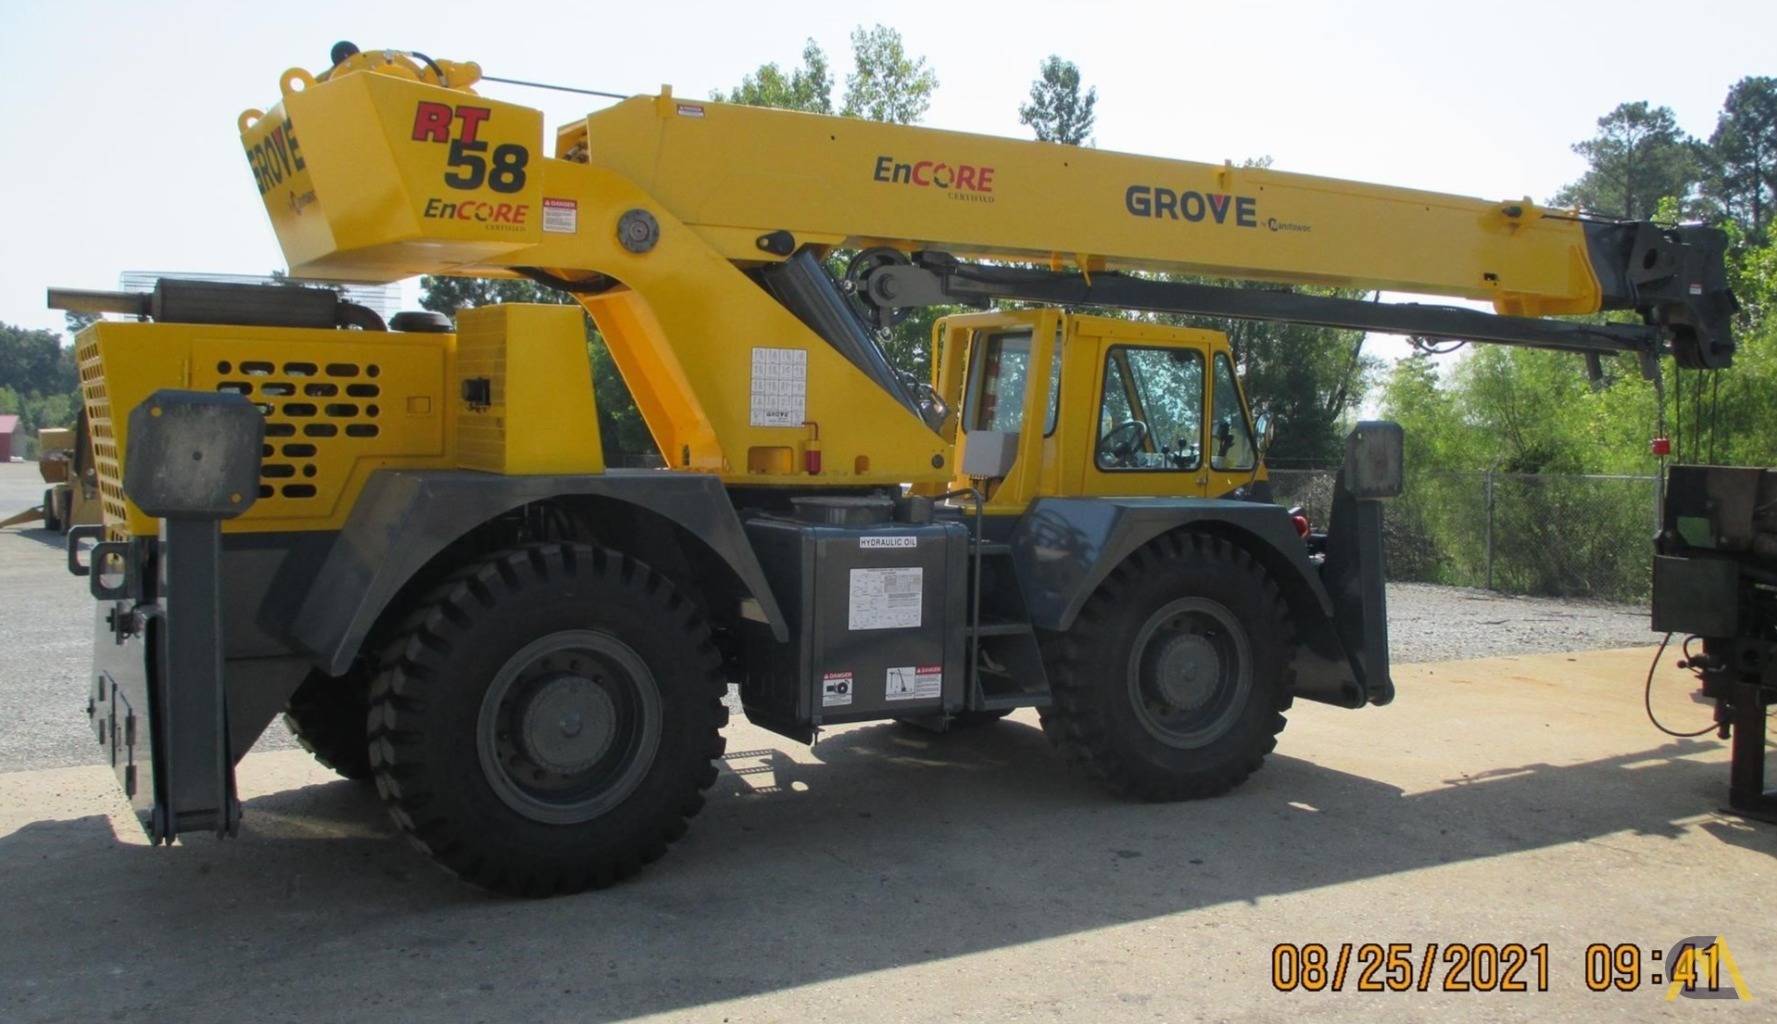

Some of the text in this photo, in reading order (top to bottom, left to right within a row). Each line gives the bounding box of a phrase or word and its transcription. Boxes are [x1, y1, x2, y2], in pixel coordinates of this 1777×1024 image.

[411, 101, 491, 144] RT
[444, 138, 529, 194] 58
[873, 155, 995, 192] EnCORE
[423, 198, 529, 224] EnCORE
[1125, 184, 1257, 228] GROVE
[861, 538, 916, 547] HYDRAULIC OIL
